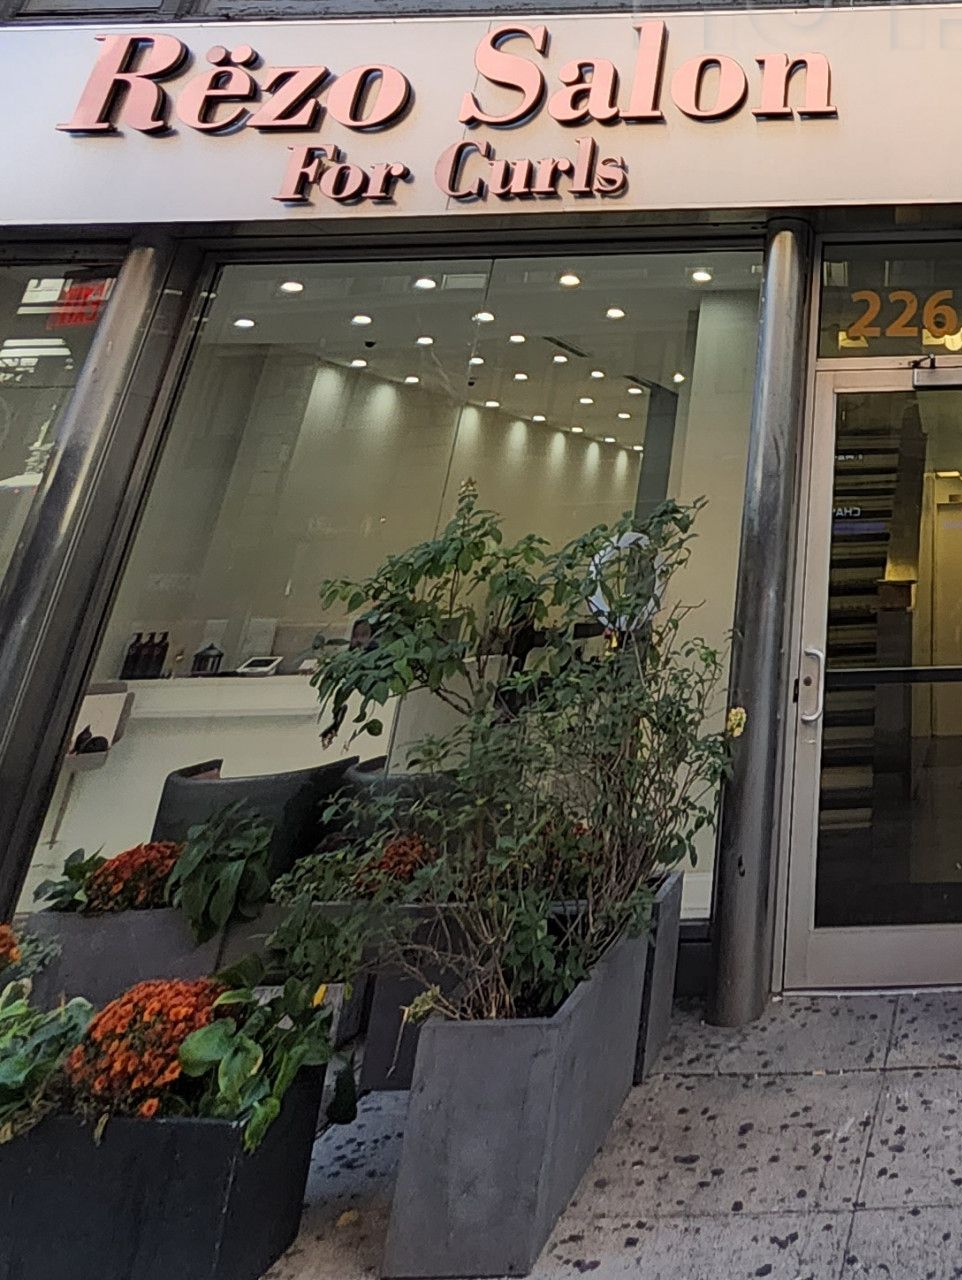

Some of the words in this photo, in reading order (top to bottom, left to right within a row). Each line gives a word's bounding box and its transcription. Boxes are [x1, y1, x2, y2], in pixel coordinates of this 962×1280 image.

[56, 32, 416, 134] Rëzo
[459, 20, 839, 128] Salon
[272, 141, 412, 205] For
[433, 136, 630, 202] Curls
[848, 288, 959, 339] 226
